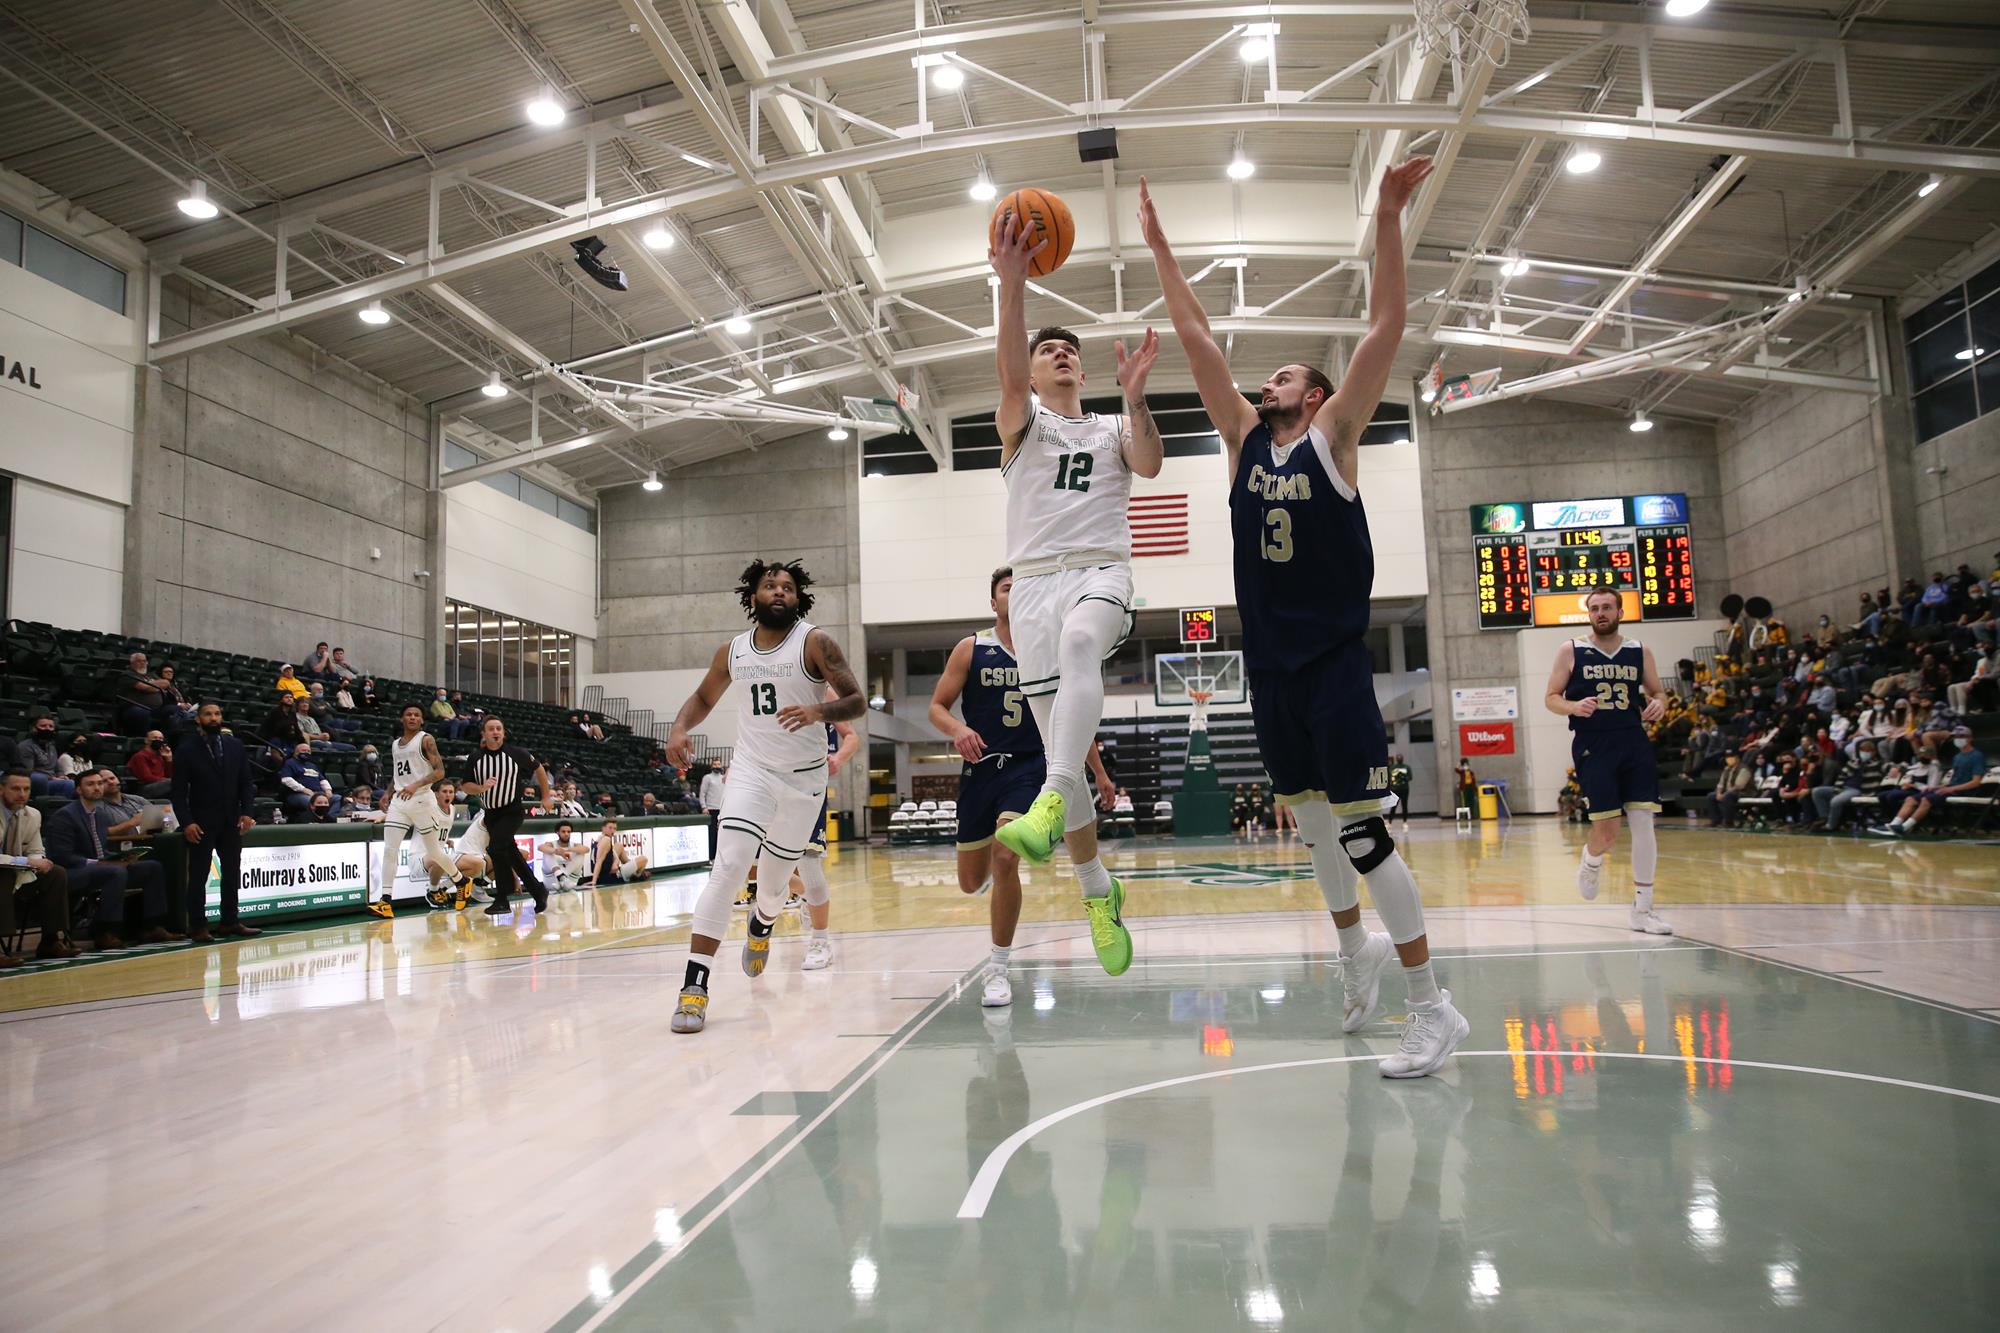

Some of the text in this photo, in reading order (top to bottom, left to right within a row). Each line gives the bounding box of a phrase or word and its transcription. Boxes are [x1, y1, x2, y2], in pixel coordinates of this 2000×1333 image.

[1054, 452, 1094, 492] 12
[1566, 530, 1601, 546] 11:46
[1646, 538, 1654, 550] 3
[1676, 536, 1688, 548] 19
[1480, 546, 1526, 559] 12 0 2
[1646, 552, 1656, 564] 5
[1681, 550, 1689, 562] 2
[1482, 559, 1526, 572] 13 3 2
[1578, 555, 1587, 568] 2
[1612, 552, 1631, 567] 53
[1644, 566, 1656, 578] 10
[1665, 565, 1673, 576] 2
[1682, 564, 1690, 576] 8
[1480, 574, 1494, 586] 20
[1541, 576, 1549, 588] 3
[1556, 574, 1564, 586] 2
[1571, 574, 1586, 586] 22
[1590, 572, 1598, 585] 2
[1604, 572, 1613, 584] 3
[1623, 572, 1632, 582] 4
[1646, 578, 1658, 591] 13
[1680, 578, 1692, 589] 12
[1480, 587, 1495, 600] 22
[1504, 586, 1512, 598] 2
[1520, 586, 1529, 596] 4
[1643, 591, 1693, 605] 23 2 3
[1481, 599, 1530, 614] 23 2 2
[1186, 610, 1213, 622] 11:46
[1187, 622, 1210, 640] 26
[750, 682, 778, 716] 13
[1596, 682, 1630, 710] 23
[1002, 690, 1024, 727] 5
[1467, 731, 1506, 742] Wilson
[397, 760, 412, 776] 24
[438, 828, 448, 841] 10
[1340, 824, 1368, 836] Mueller
[272, 854, 286, 862] Since
[288, 852, 300, 860] 1919
[298, 868, 306, 884] &
[309, 864, 338, 882] Sons,
[342, 862, 360, 880] Inc.
[277, 900, 306, 908] BROOKINGS
[312, 896, 332, 904] GRANTS
